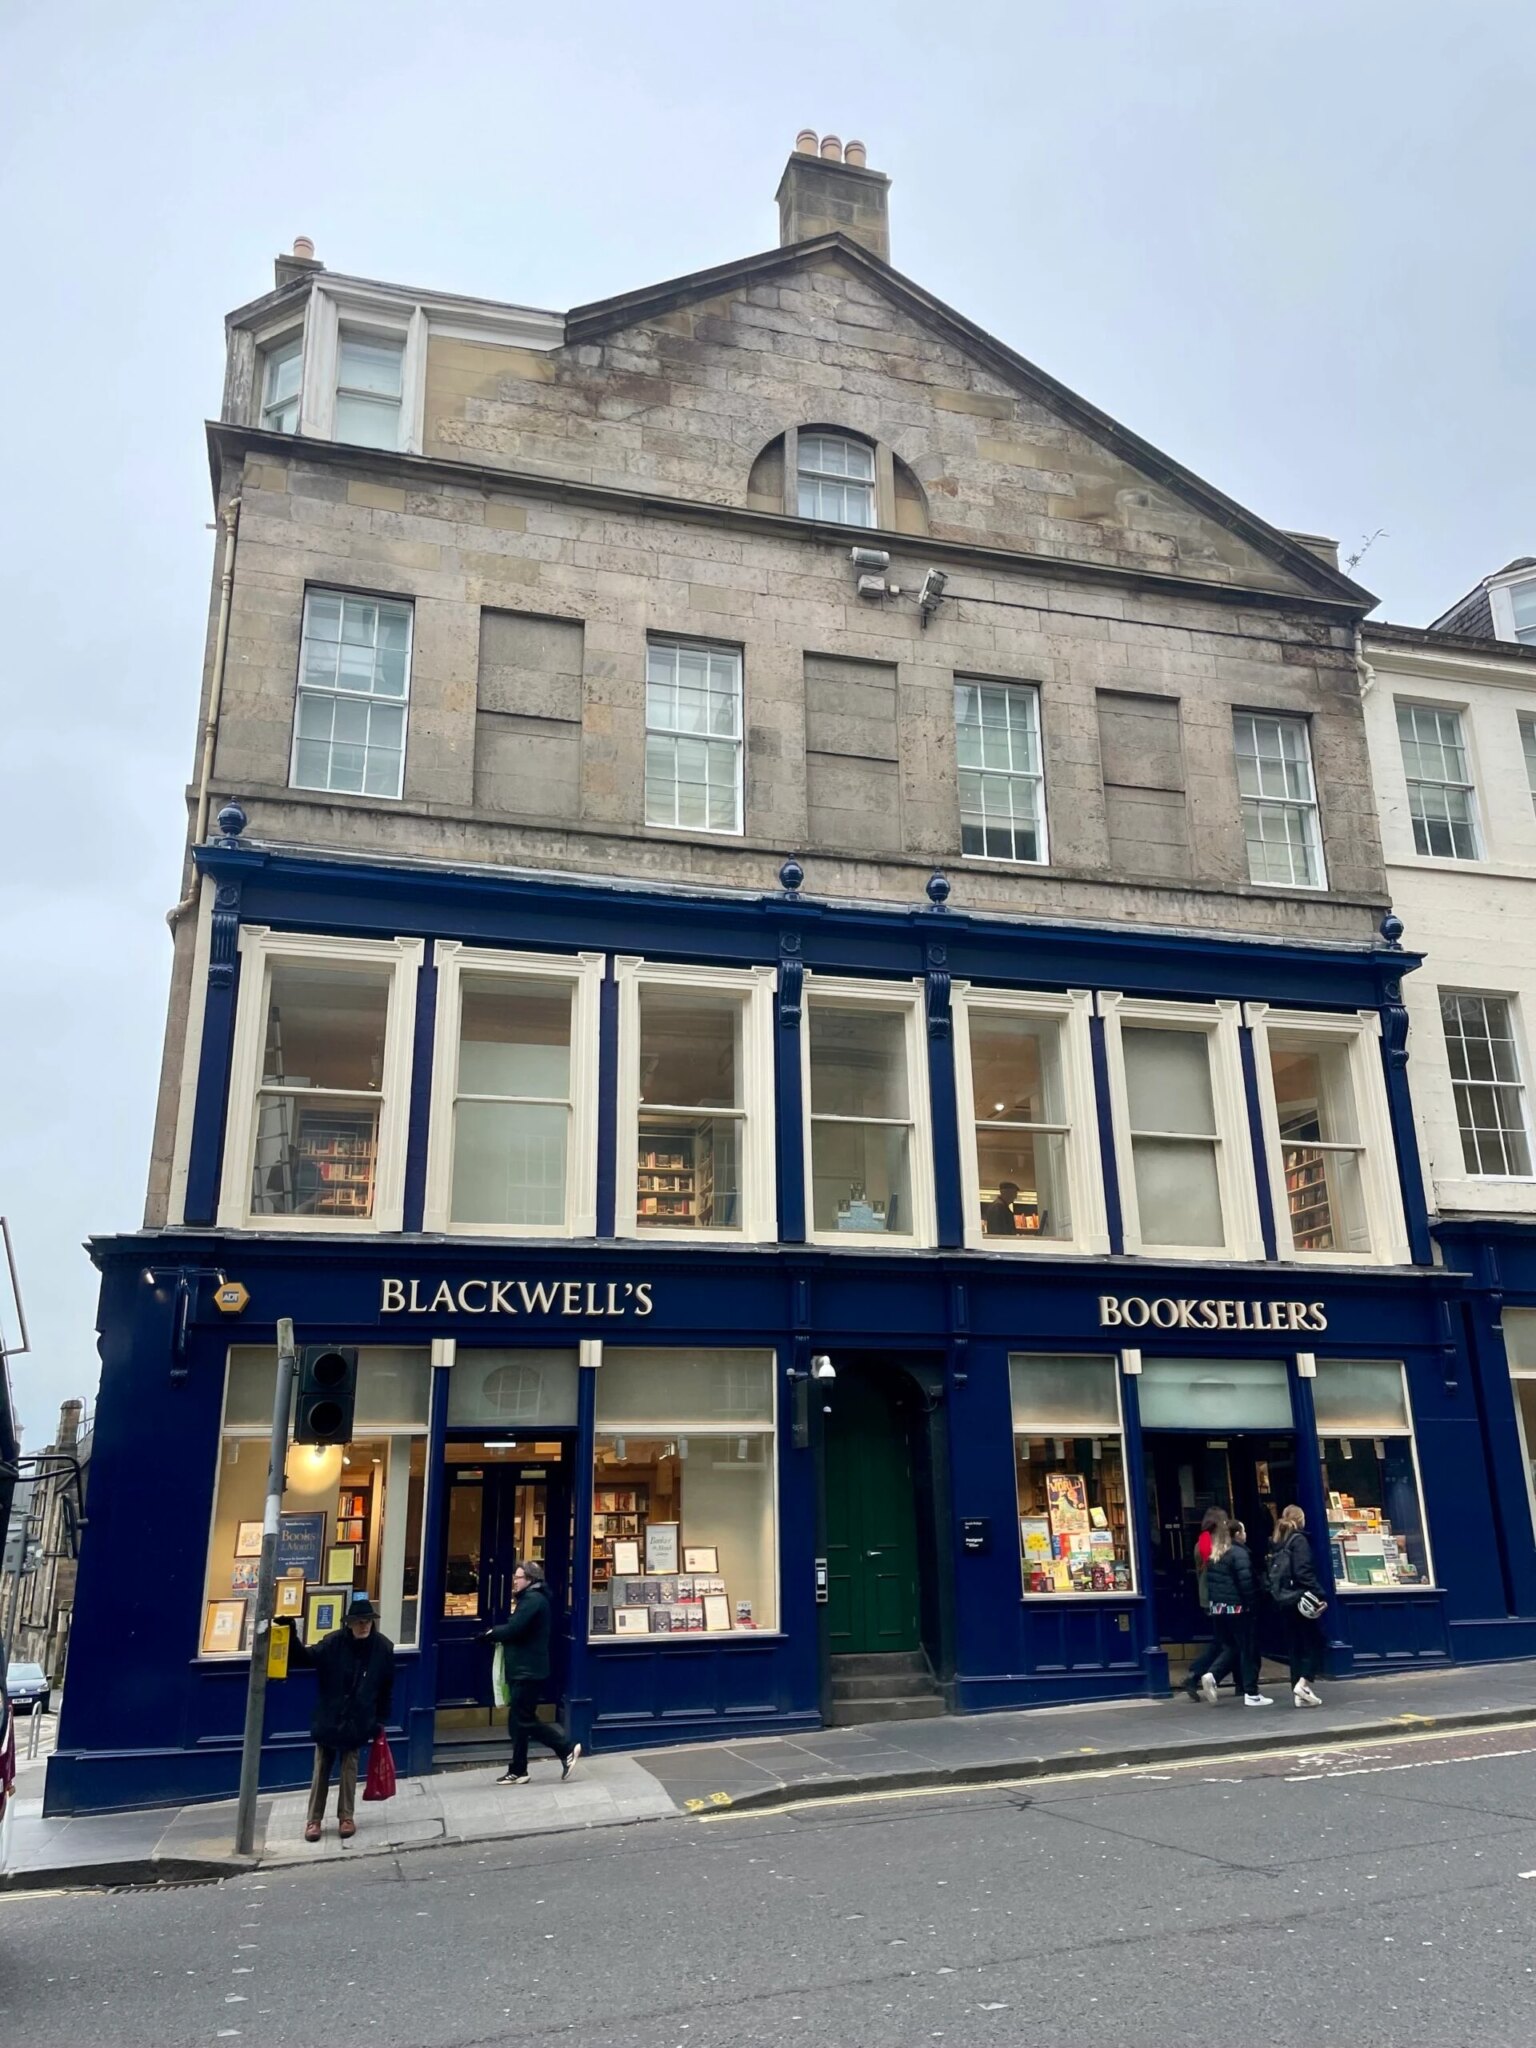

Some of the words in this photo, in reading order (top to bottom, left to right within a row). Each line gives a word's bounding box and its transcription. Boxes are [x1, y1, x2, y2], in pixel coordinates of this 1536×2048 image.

[222, 1292, 240, 1302] ADT
[380, 1279, 654, 1315] BLACKWELL'S
[1099, 1295, 1328, 1331] BOOKSELLERS
[282, 1529, 316, 1541] Books
